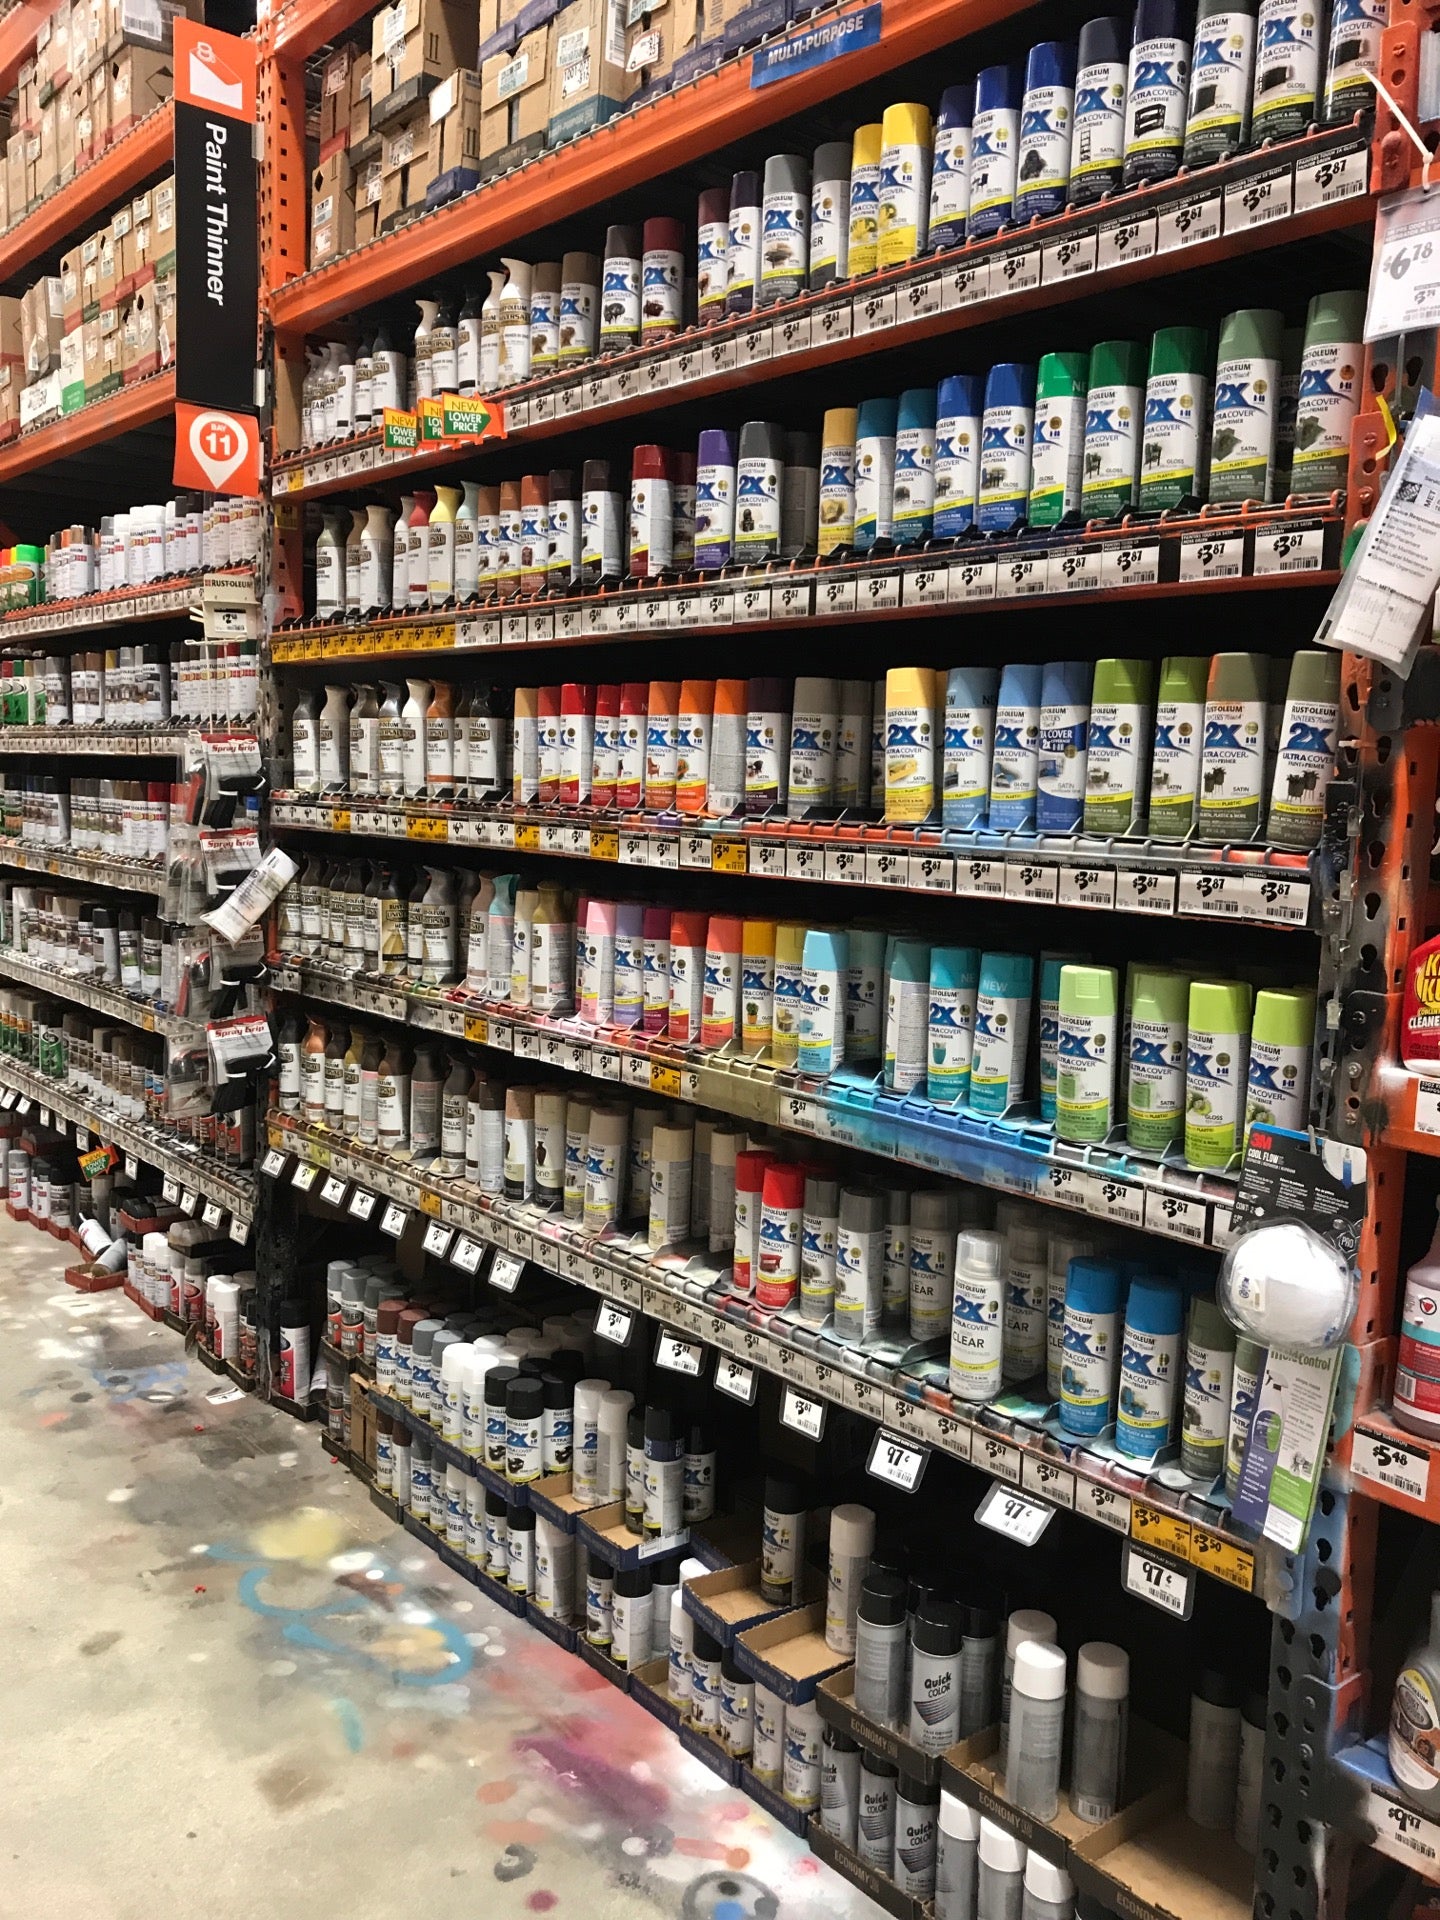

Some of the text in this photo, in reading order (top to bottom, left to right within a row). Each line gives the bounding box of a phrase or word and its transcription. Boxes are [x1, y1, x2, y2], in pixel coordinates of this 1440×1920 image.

[767, 14, 865, 67] MULTI-PURPOSE
[1135, 61, 1173, 88] 2X
[1150, 89, 1178, 98] COVER
[206, 122, 228, 306] Paint Thinner
[452, 401, 479, 412] NEW
[1312, 398, 1341, 407] COVER
[449, 412, 482, 424] LOWER
[1227, 410, 1255, 418] COVER
[392, 415, 416, 426] NEW
[210, 423, 226, 432] BAY
[452, 423, 479, 433] PRICE
[1158, 424, 1181, 432] COVER
[204, 432, 231, 457] 11
[393, 436, 415, 446] PRICE
[1096, 435, 1119, 443] COVER
[1312, 452, 1332, 460] PLASTIC
[1105, 467, 1123, 475] GLOSS
[1229, 461, 1249, 469] PLASTIC
[1424, 490, 1437, 507] MET
[1291, 705, 1336, 718] RUST-OLEUM
[887, 724, 917, 746] 2X
[1048, 730, 1073, 739] COVER
[1205, 721, 1242, 749] 2X
[1286, 722, 1334, 754] 2X
[211, 743, 256, 753] Spray Grip
[1224, 751, 1248, 759] COVER
[1283, 753, 1306, 761] ULTRA
[207, 838, 255, 849] Spray Grip
[983, 980, 1008, 992] NEW
[215, 1024, 265, 1038] Spray Grip
[1059, 1030, 1090, 1057] 2X
[1131, 1038, 1167, 1064] 2X
[1071, 1059, 1096, 1068] COVER
[1147, 1067, 1172, 1075] COVER
[1261, 1088, 1286, 1100] COVER
[1250, 1132, 1272, 1150] 3M
[1248, 1148, 1279, 1163] COOL FLOW
[1341, 1236, 1354, 1248] PRO
[911, 1283, 934, 1296] LEAR
[954, 1295, 985, 1323] 2X
[952, 1331, 985, 1349] CLEAR
[924, 1671, 952, 1690] Quick
[928, 1685, 951, 1698] COLOR
[851, 1719, 888, 1749] ECONOMY
[864, 1791, 889, 1805] Quick
[866, 1804, 888, 1814] COLOR
[979, 1791, 1021, 1832] ECONOMY
[906, 1820, 934, 1838] Quick
[910, 1832, 932, 1846] COLOR
